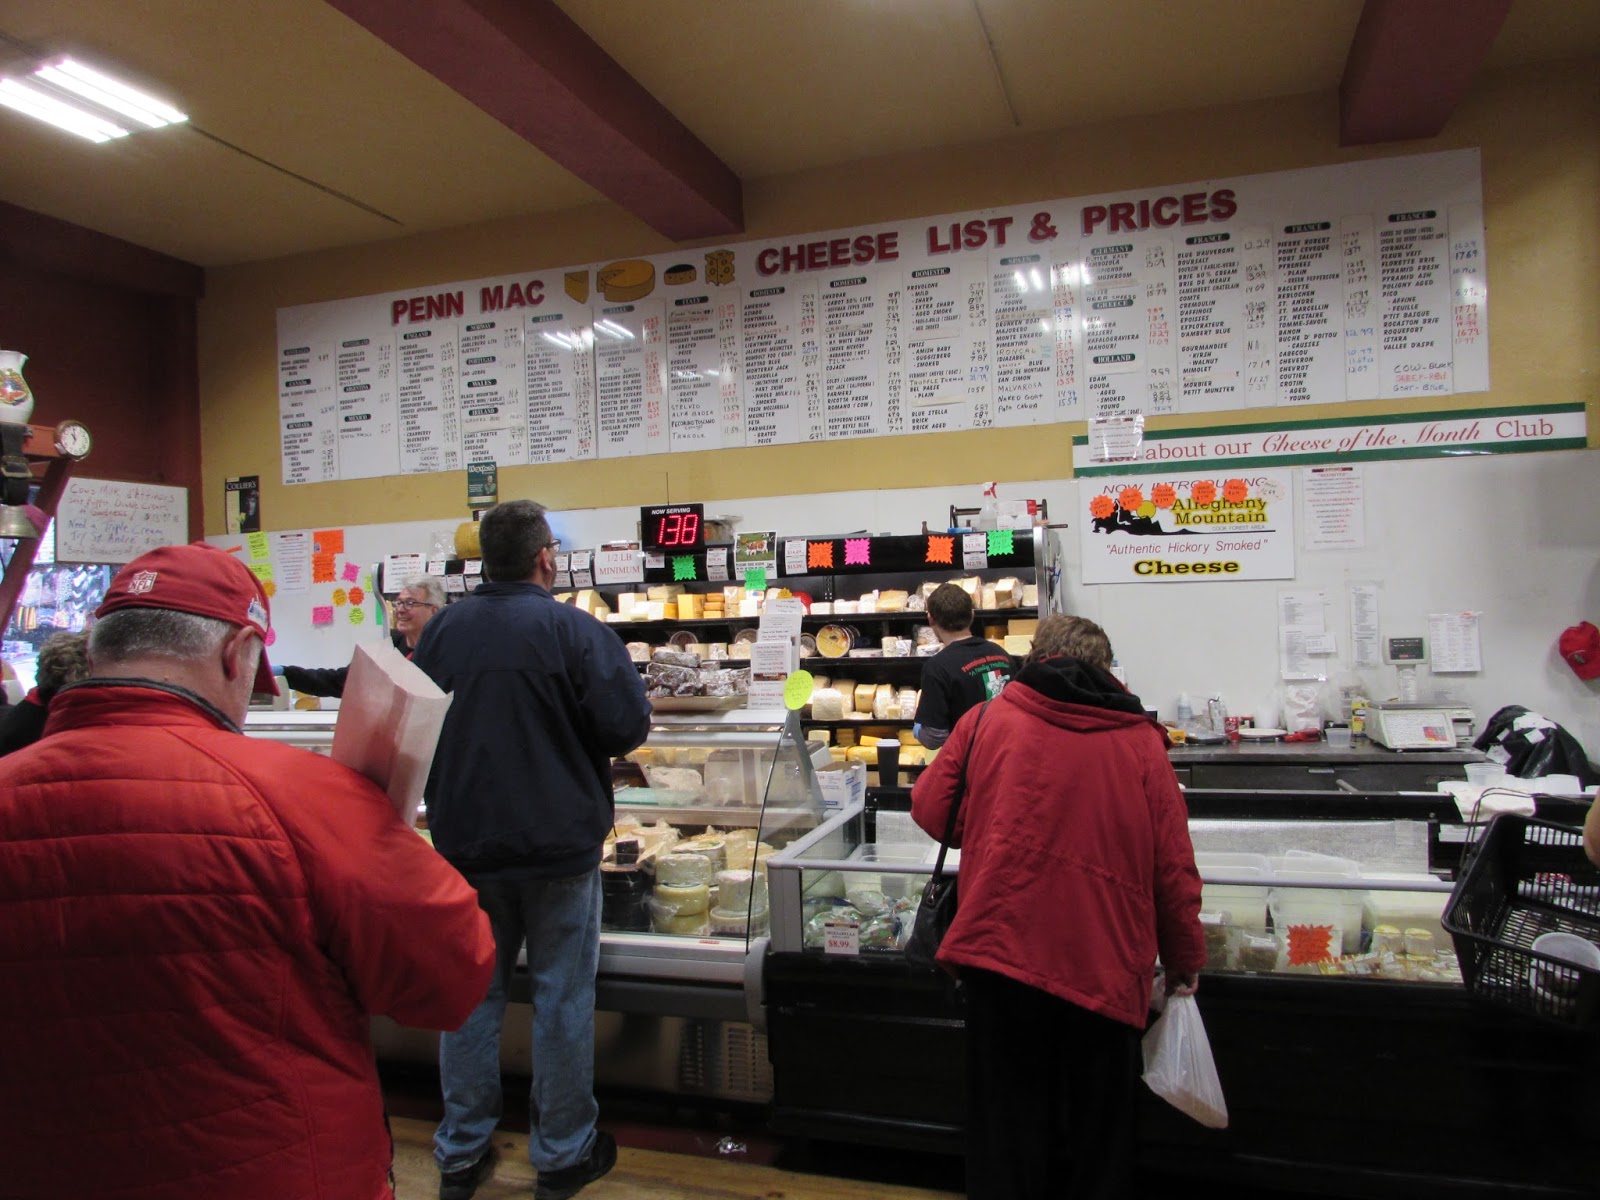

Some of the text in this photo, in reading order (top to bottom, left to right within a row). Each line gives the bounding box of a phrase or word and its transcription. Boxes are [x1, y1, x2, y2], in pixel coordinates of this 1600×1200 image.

[392, 190, 1238, 325] PENN MAC CHEESE LIST & PRICES
[1381, 252, 1402, 260] FLEUR
[1381, 259, 1415, 267] FLORETTE
[915, 268, 946, 278] DOMESTIC
[1381, 266, 1414, 275] PYRAMID
[1381, 274, 1414, 282] PYRAMID
[1392, 304, 1419, 312] FEUILLE
[1292, 312, 1324, 320] NECTAIRE
[1180, 322, 1224, 331] EXPLORATEUR
[1383, 319, 1419, 328] ROCASTON
[1383, 327, 1424, 335] ROQUEFORT
[1181, 343, 1227, 352] GOURMANDISE
[1291, 341, 1320, 349] CAUSSES
[1097, 354, 1131, 363] HOLLAND
[1279, 357, 1314, 365] CHEVERON
[1279, 372, 1307, 380] COUTIER
[1204, 386, 1235, 394] MUNSTER
[1146, 419, 1554, 460] about our Cheese of the Month Club
[227, 482, 257, 490] COLLIER'S
[1175, 512, 1266, 524] Mountain
[659, 515, 698, 544] 138
[1106, 540, 1268, 555] "Authentic Hickory Smoked"
[600, 567, 640, 575] MINIMUM
[1135, 561, 1239, 575] Cheese
[130, 580, 150, 590] NFL
[829, 940, 849, 948] $8.99
